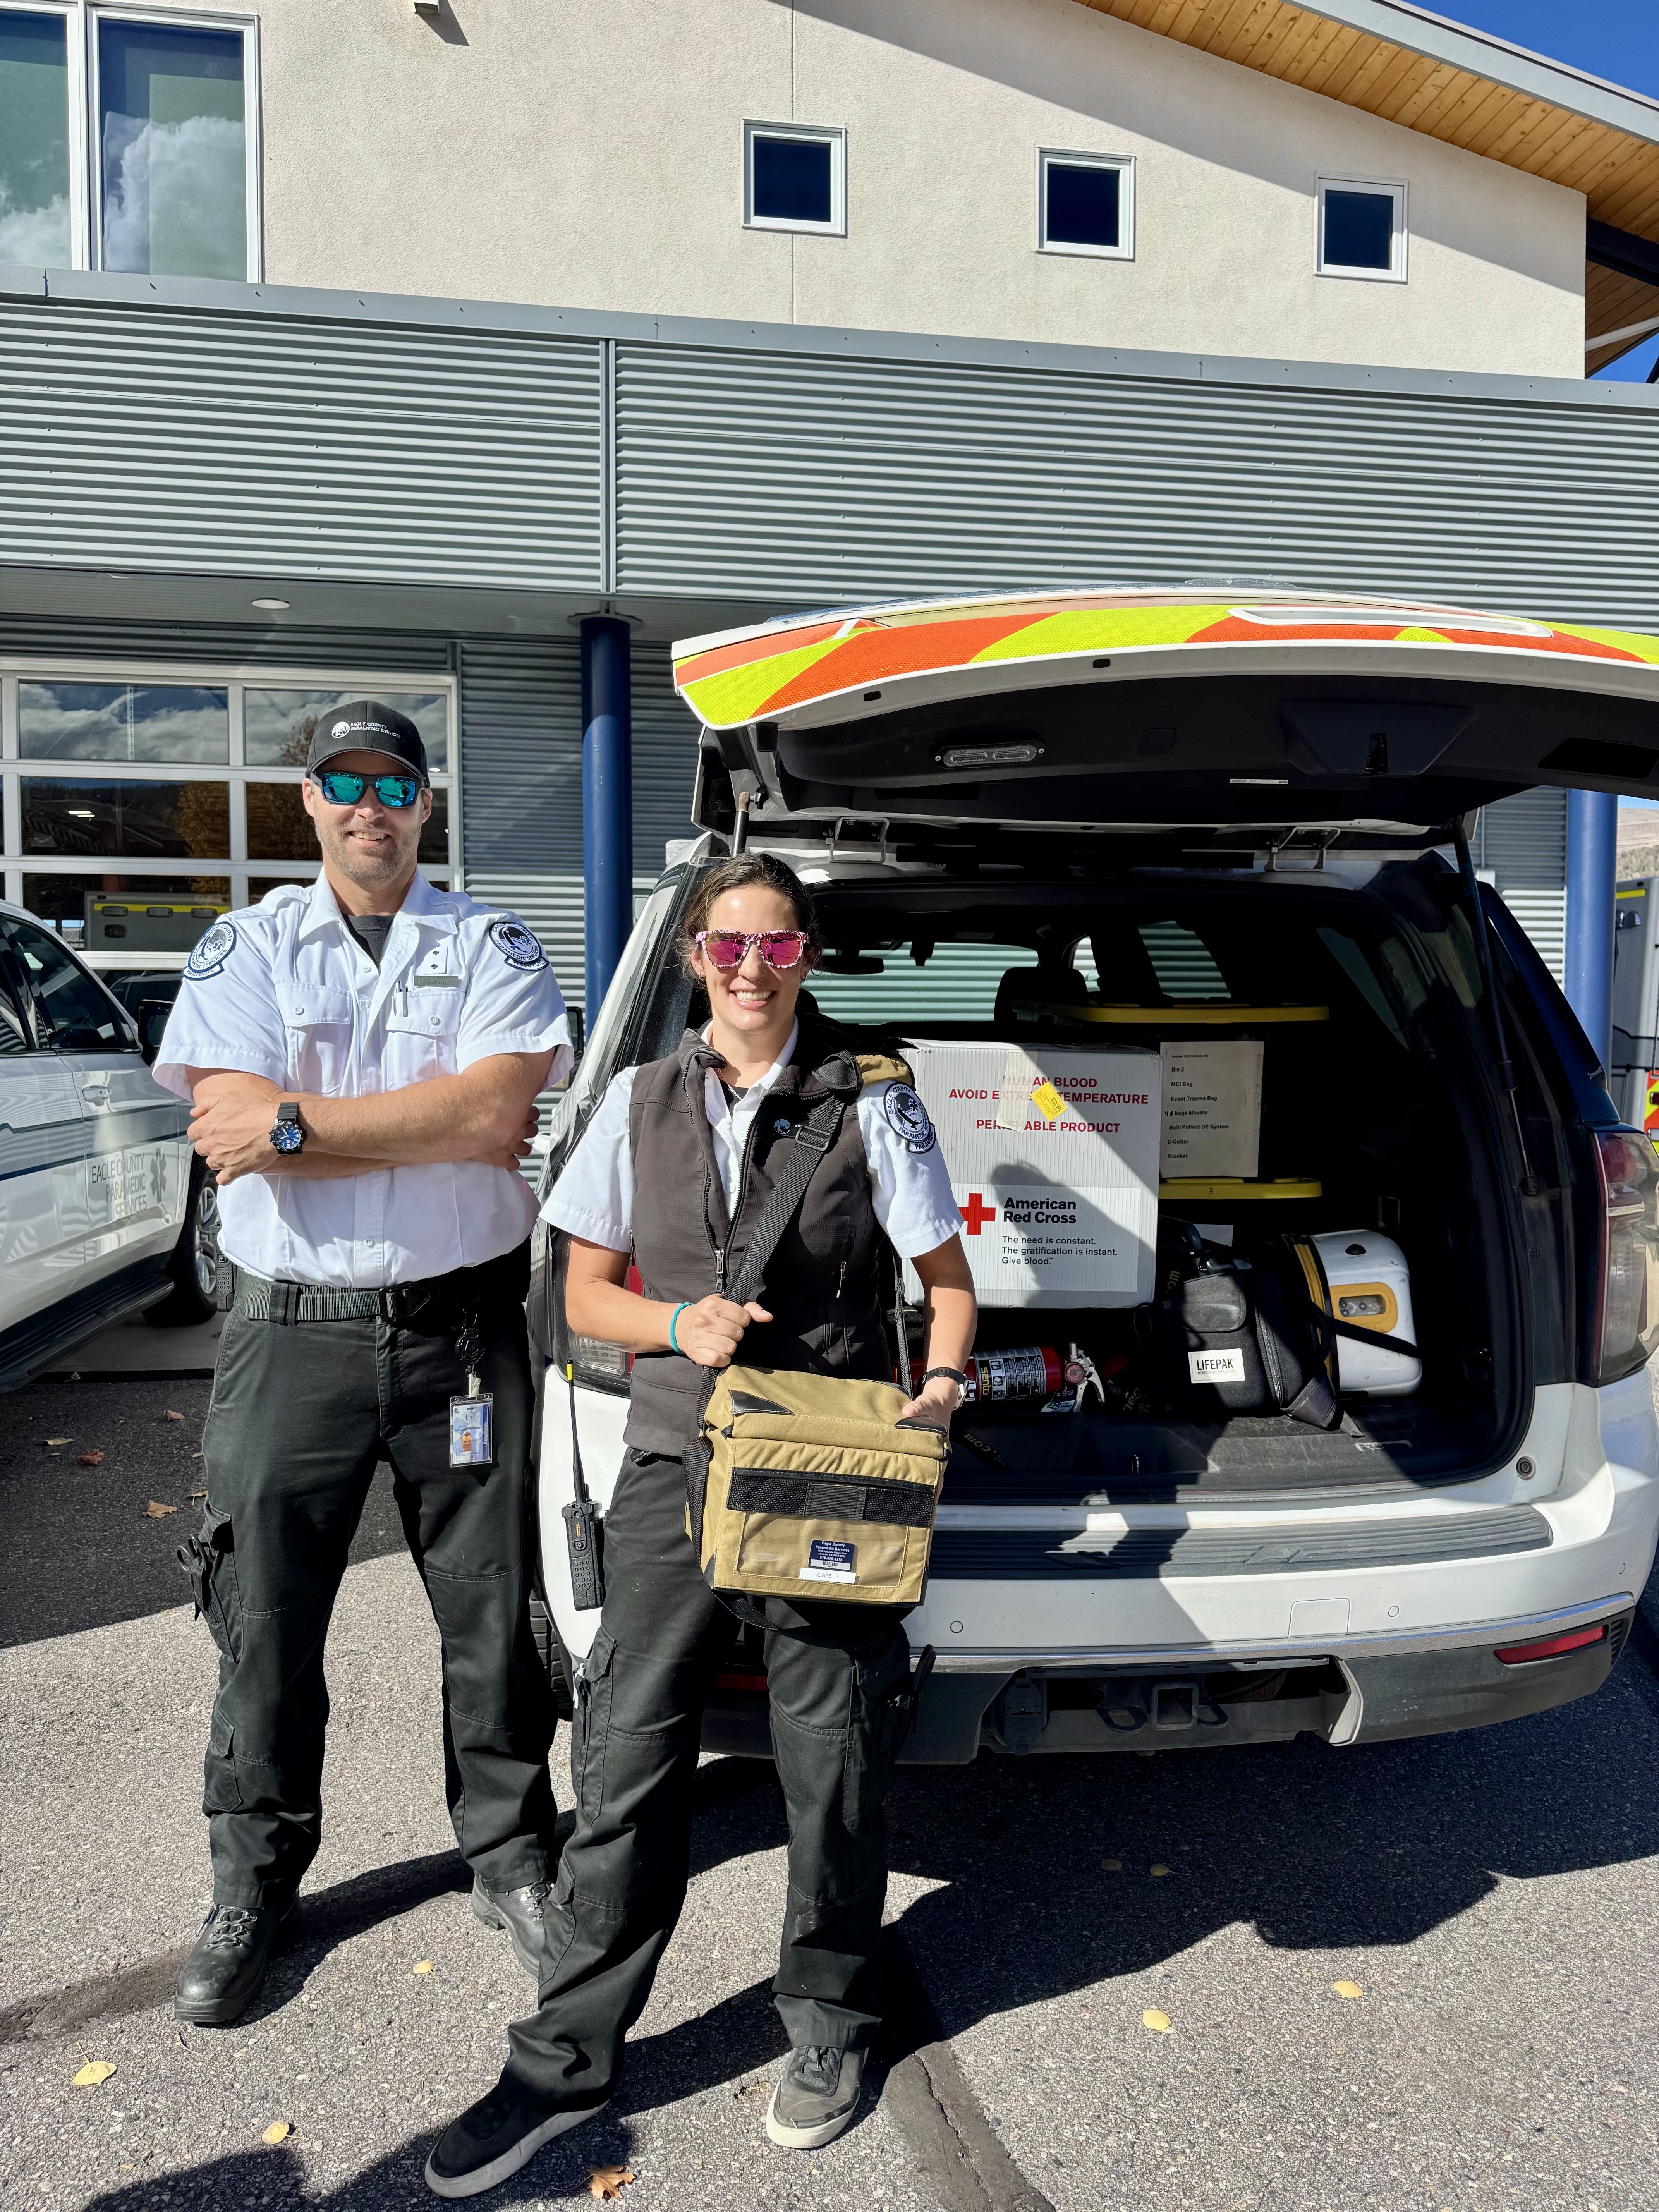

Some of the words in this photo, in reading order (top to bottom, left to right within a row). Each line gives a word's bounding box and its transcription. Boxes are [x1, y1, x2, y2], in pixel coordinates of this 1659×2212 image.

[202, 950, 227, 968] SERVICES
[1054, 1077, 1097, 1088] BLOOD
[949, 1089, 988, 1099] AVOID
[1058, 1092, 1149, 1104] TEMPERATURE
[898, 1127, 926, 1139] PARAMEDIC
[1060, 1122, 1120, 1133] PRODUCT
[92, 1160, 115, 1183] EAGLE
[116, 1152, 144, 1176] COUNTY
[105, 1173, 146, 1202] PARAMEDIC
[115, 1195, 147, 1216] SERVICES
[1003, 1197, 1076, 1210] American
[1003, 1211, 1031, 1223] Red
[1034, 1211, 1076, 1224] Cross
[1021, 1247, 1073, 1255] gratification
[1197, 1358, 1233, 1370] LIFEPAK
[981, 1367, 991, 1396] sentry
